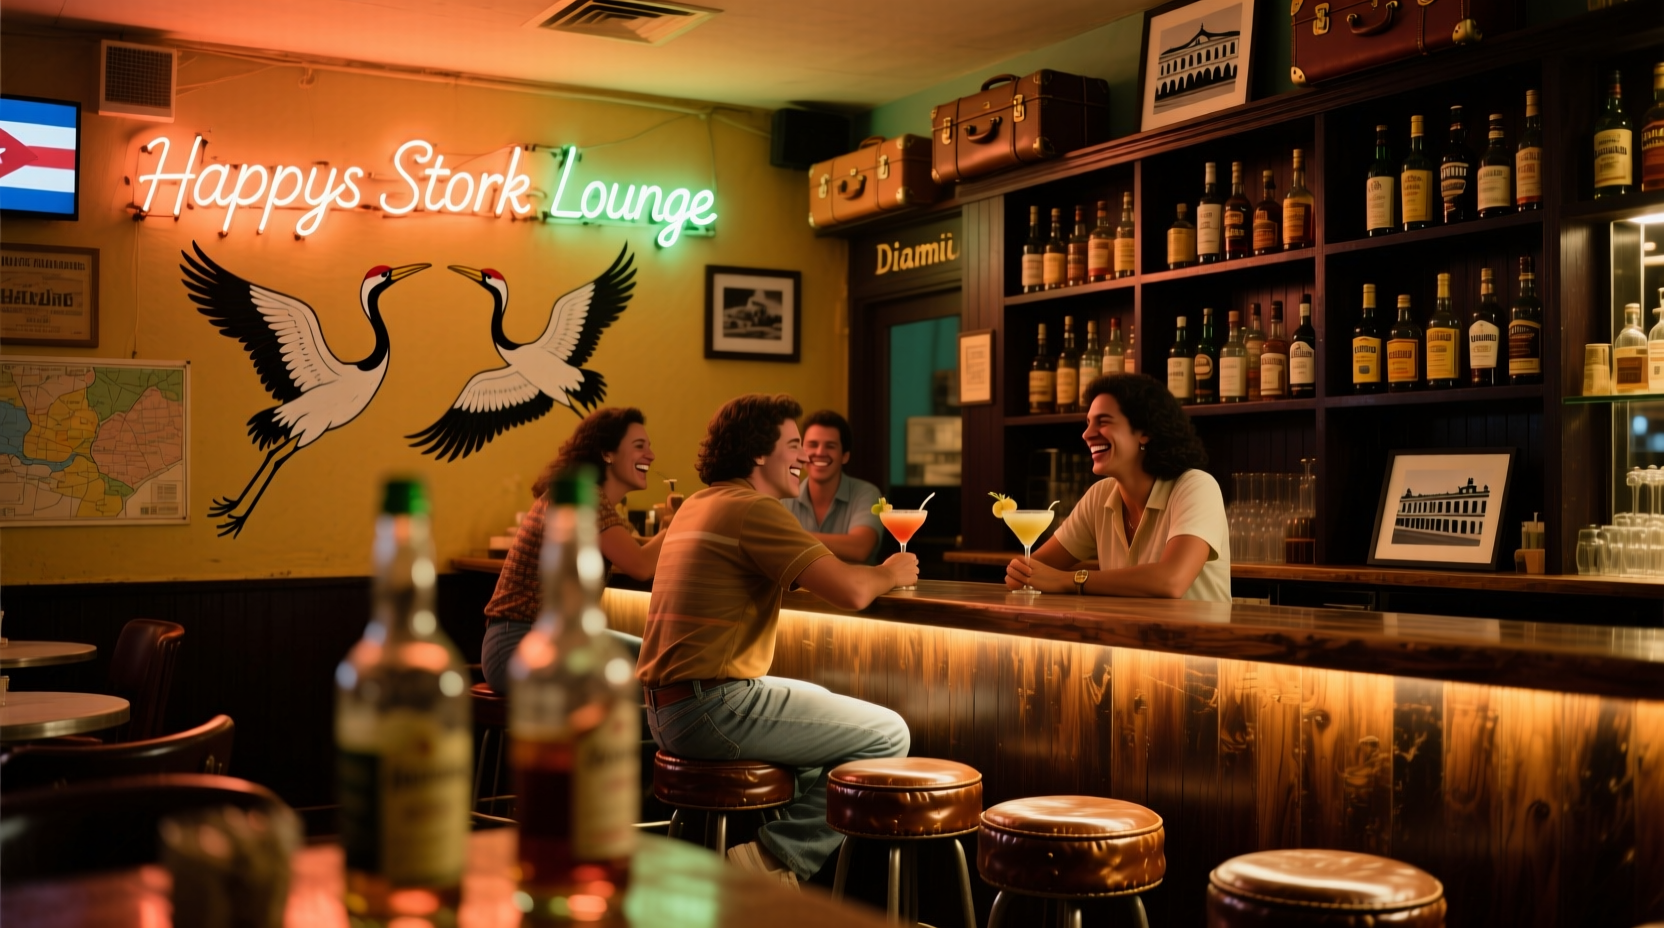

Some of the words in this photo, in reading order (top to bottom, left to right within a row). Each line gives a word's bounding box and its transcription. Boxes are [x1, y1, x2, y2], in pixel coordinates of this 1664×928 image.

[139, 135, 363, 237] Happys
[380, 140, 531, 217] Stork
[550, 146, 718, 249] Lounge
